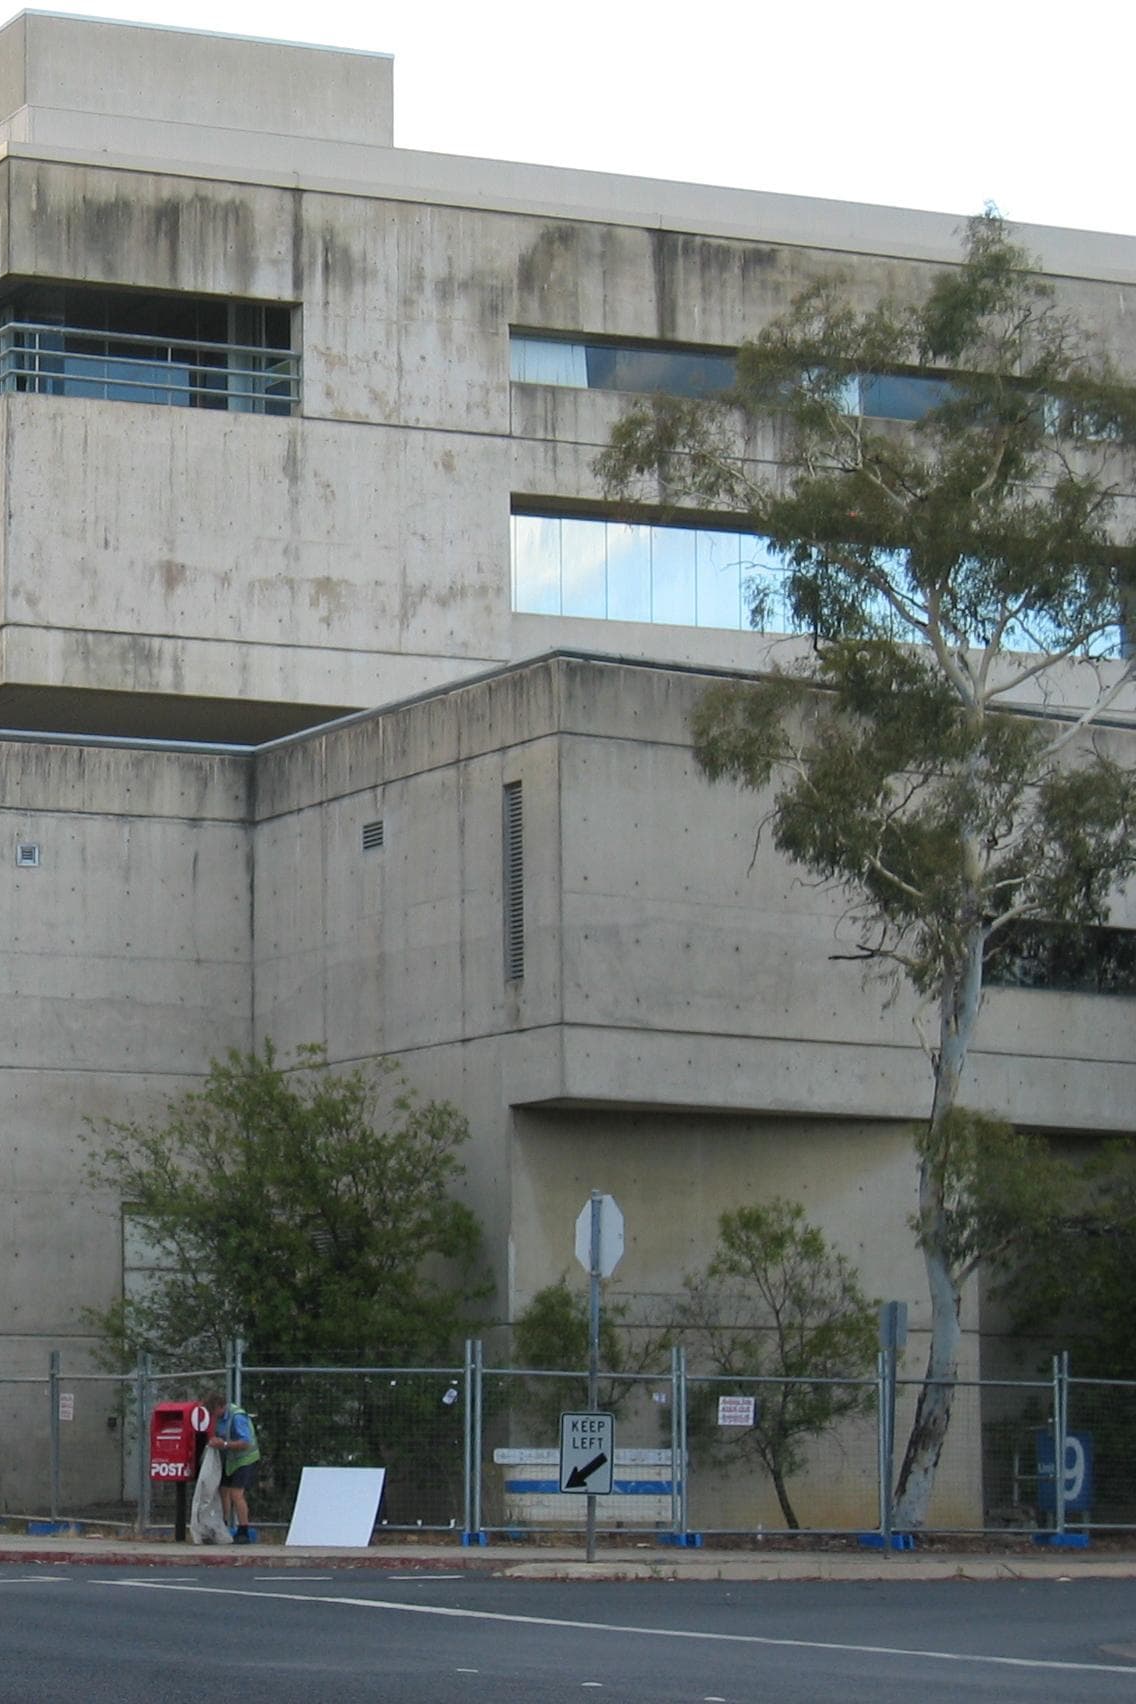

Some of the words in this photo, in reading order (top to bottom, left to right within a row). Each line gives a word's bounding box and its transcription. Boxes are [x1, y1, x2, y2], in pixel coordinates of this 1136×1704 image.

[571, 1420, 605, 1433] KEEP
[572, 1437, 603, 1449] LEFT
[151, 1463, 184, 1477] POST
[1058, 1436, 1084, 1500] 9
